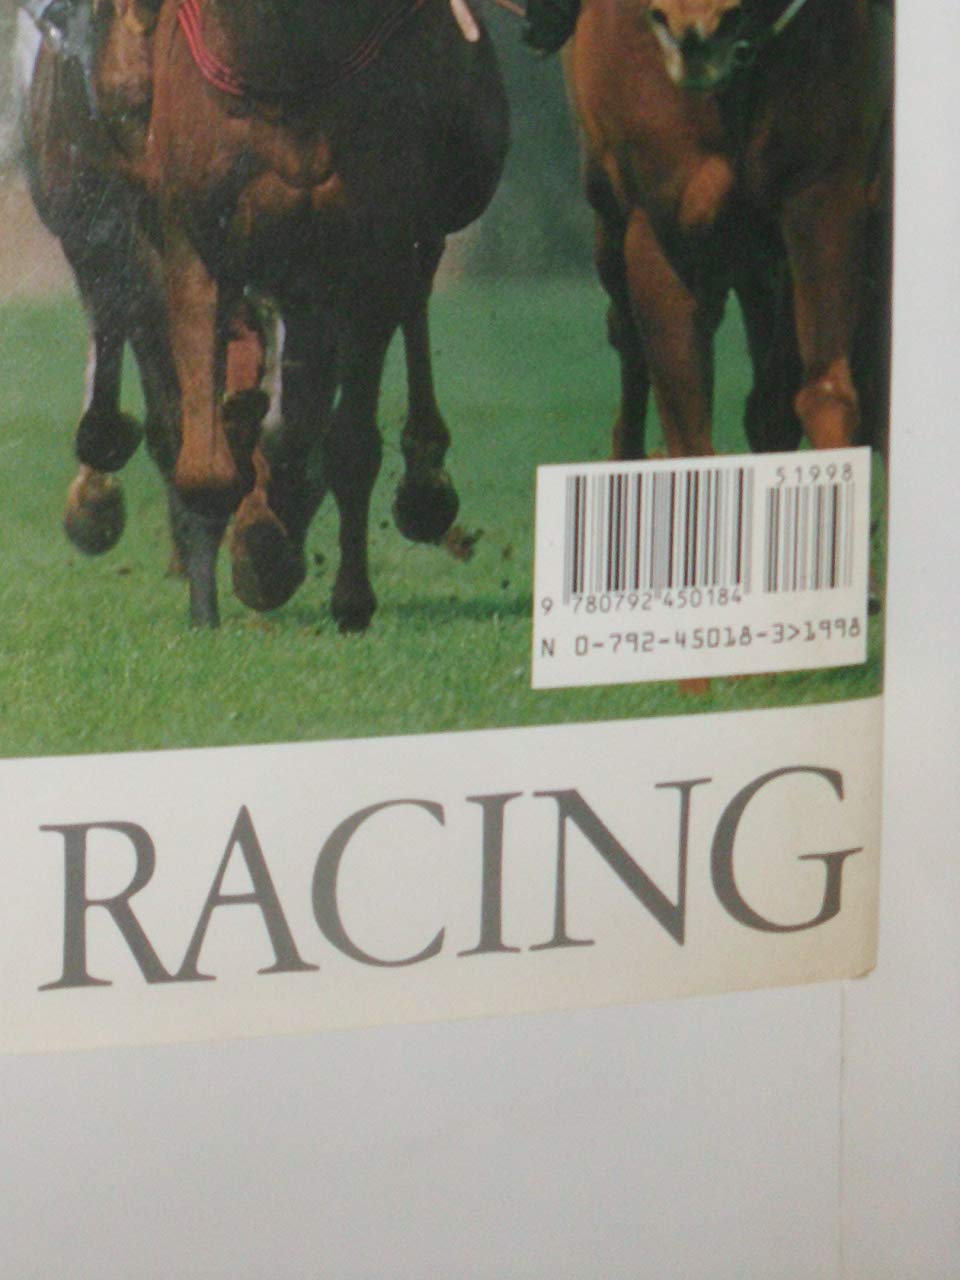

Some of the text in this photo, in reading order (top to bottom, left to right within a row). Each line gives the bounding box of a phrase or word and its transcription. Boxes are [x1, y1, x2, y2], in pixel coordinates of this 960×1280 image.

[775, 462, 855, 484] 51998
[541, 588, 743, 615] 9 780792 450184
[540, 638, 557, 658] N
[37, 764, 864, 993] RACING
